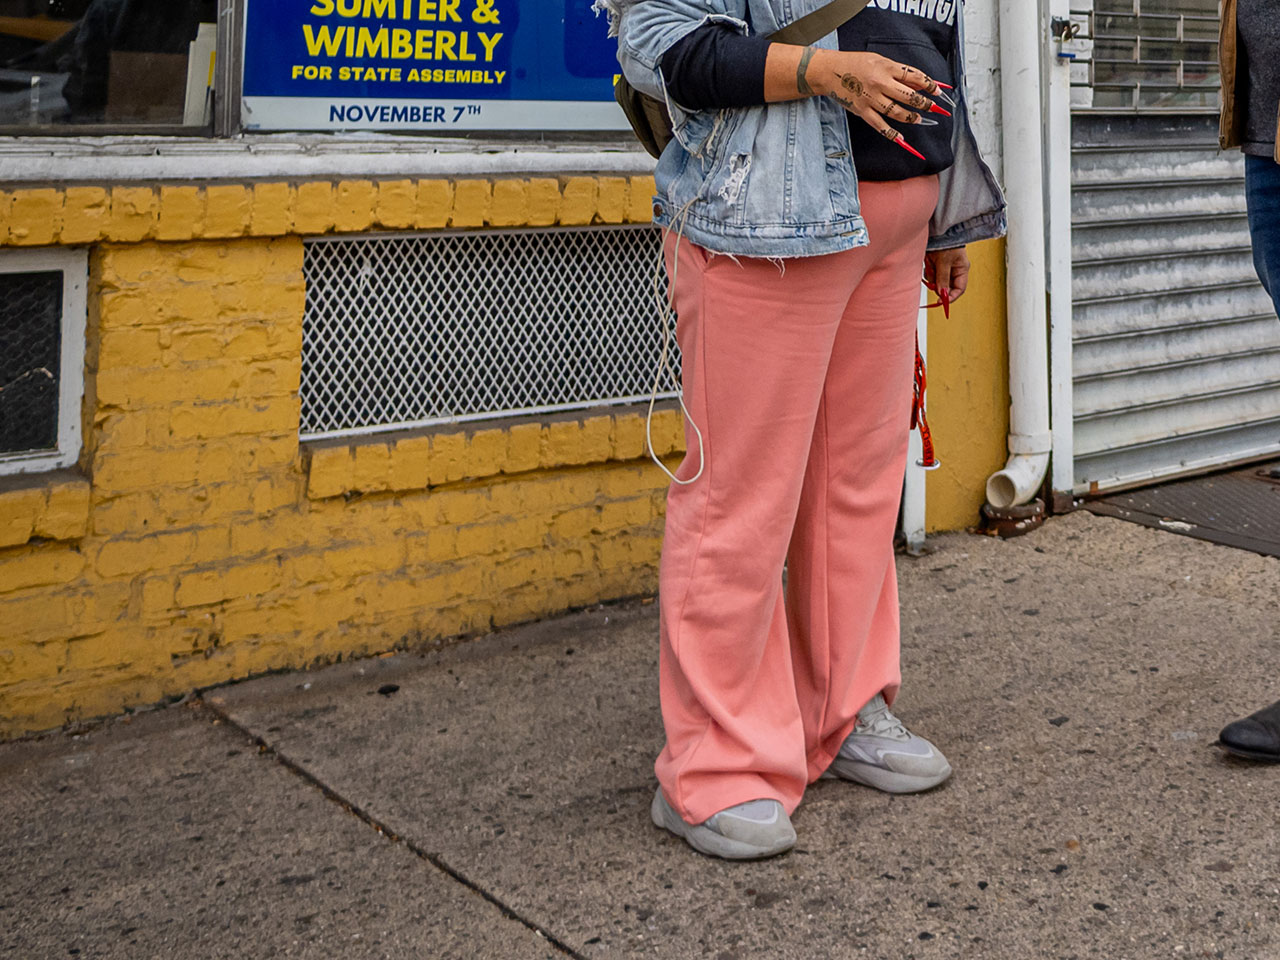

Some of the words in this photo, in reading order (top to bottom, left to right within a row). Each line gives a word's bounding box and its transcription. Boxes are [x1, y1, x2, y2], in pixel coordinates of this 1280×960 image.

[302, 24, 504, 63] WIMBERLY
[291, 65, 332, 80] FOR
[338, 66, 401, 82] STATE
[406, 68, 507, 85] ASSEMBLY
[329, 104, 446, 123] NOVEMBER
